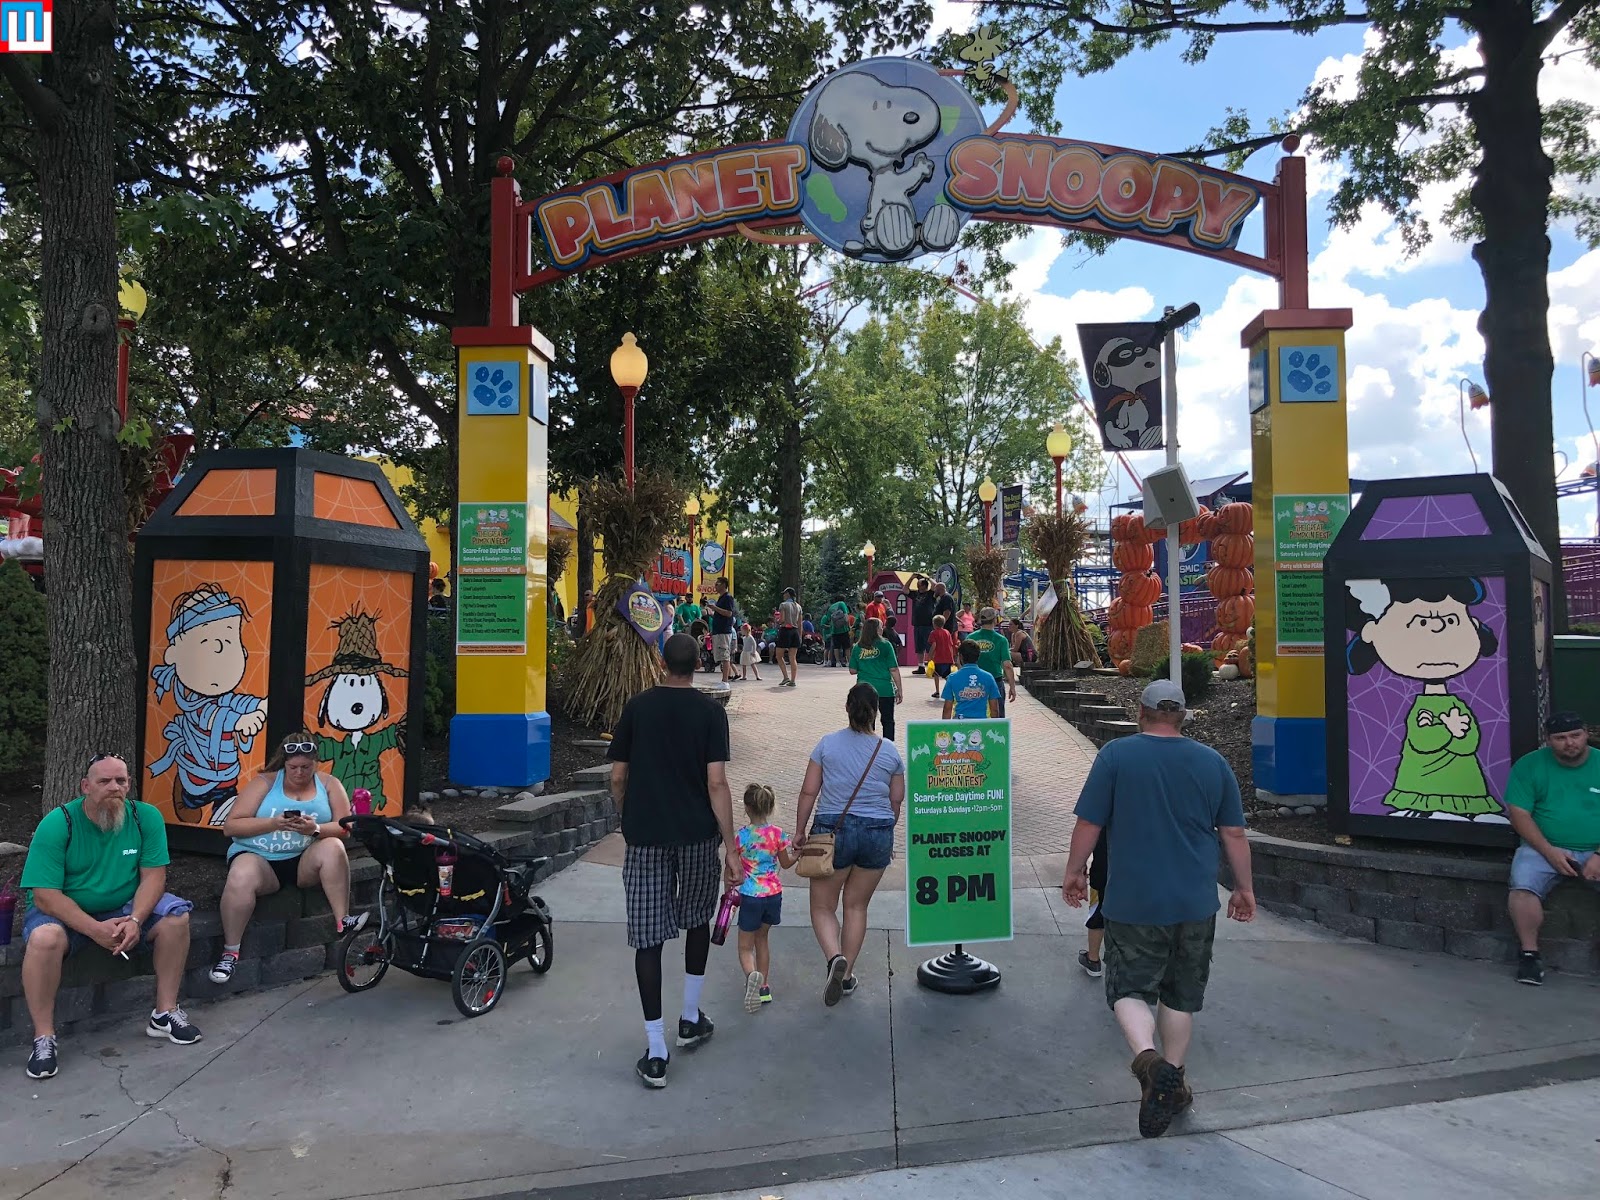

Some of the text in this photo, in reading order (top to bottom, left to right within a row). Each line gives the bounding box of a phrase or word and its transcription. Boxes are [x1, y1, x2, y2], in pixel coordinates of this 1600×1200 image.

[540, 138, 1256, 262] PLANET SNOOPY
[1179, 564, 1200, 573] SMIC
[652, 571, 688, 595] Baron
[936, 763, 976, 776] THE GREAT
[927, 773, 984, 788] PUMPKIN FEST
[914, 789, 1004, 803] Scare-Free Daytime FUN!
[914, 806, 942, 815] Saturdays
[943, 806, 948, 814] &
[948, 805, 971, 815] Sundays
[912, 830, 1006, 844] PLANET SNOOPY
[928, 844, 991, 858] CLOSES AT
[916, 873, 996, 905] 8 PM
